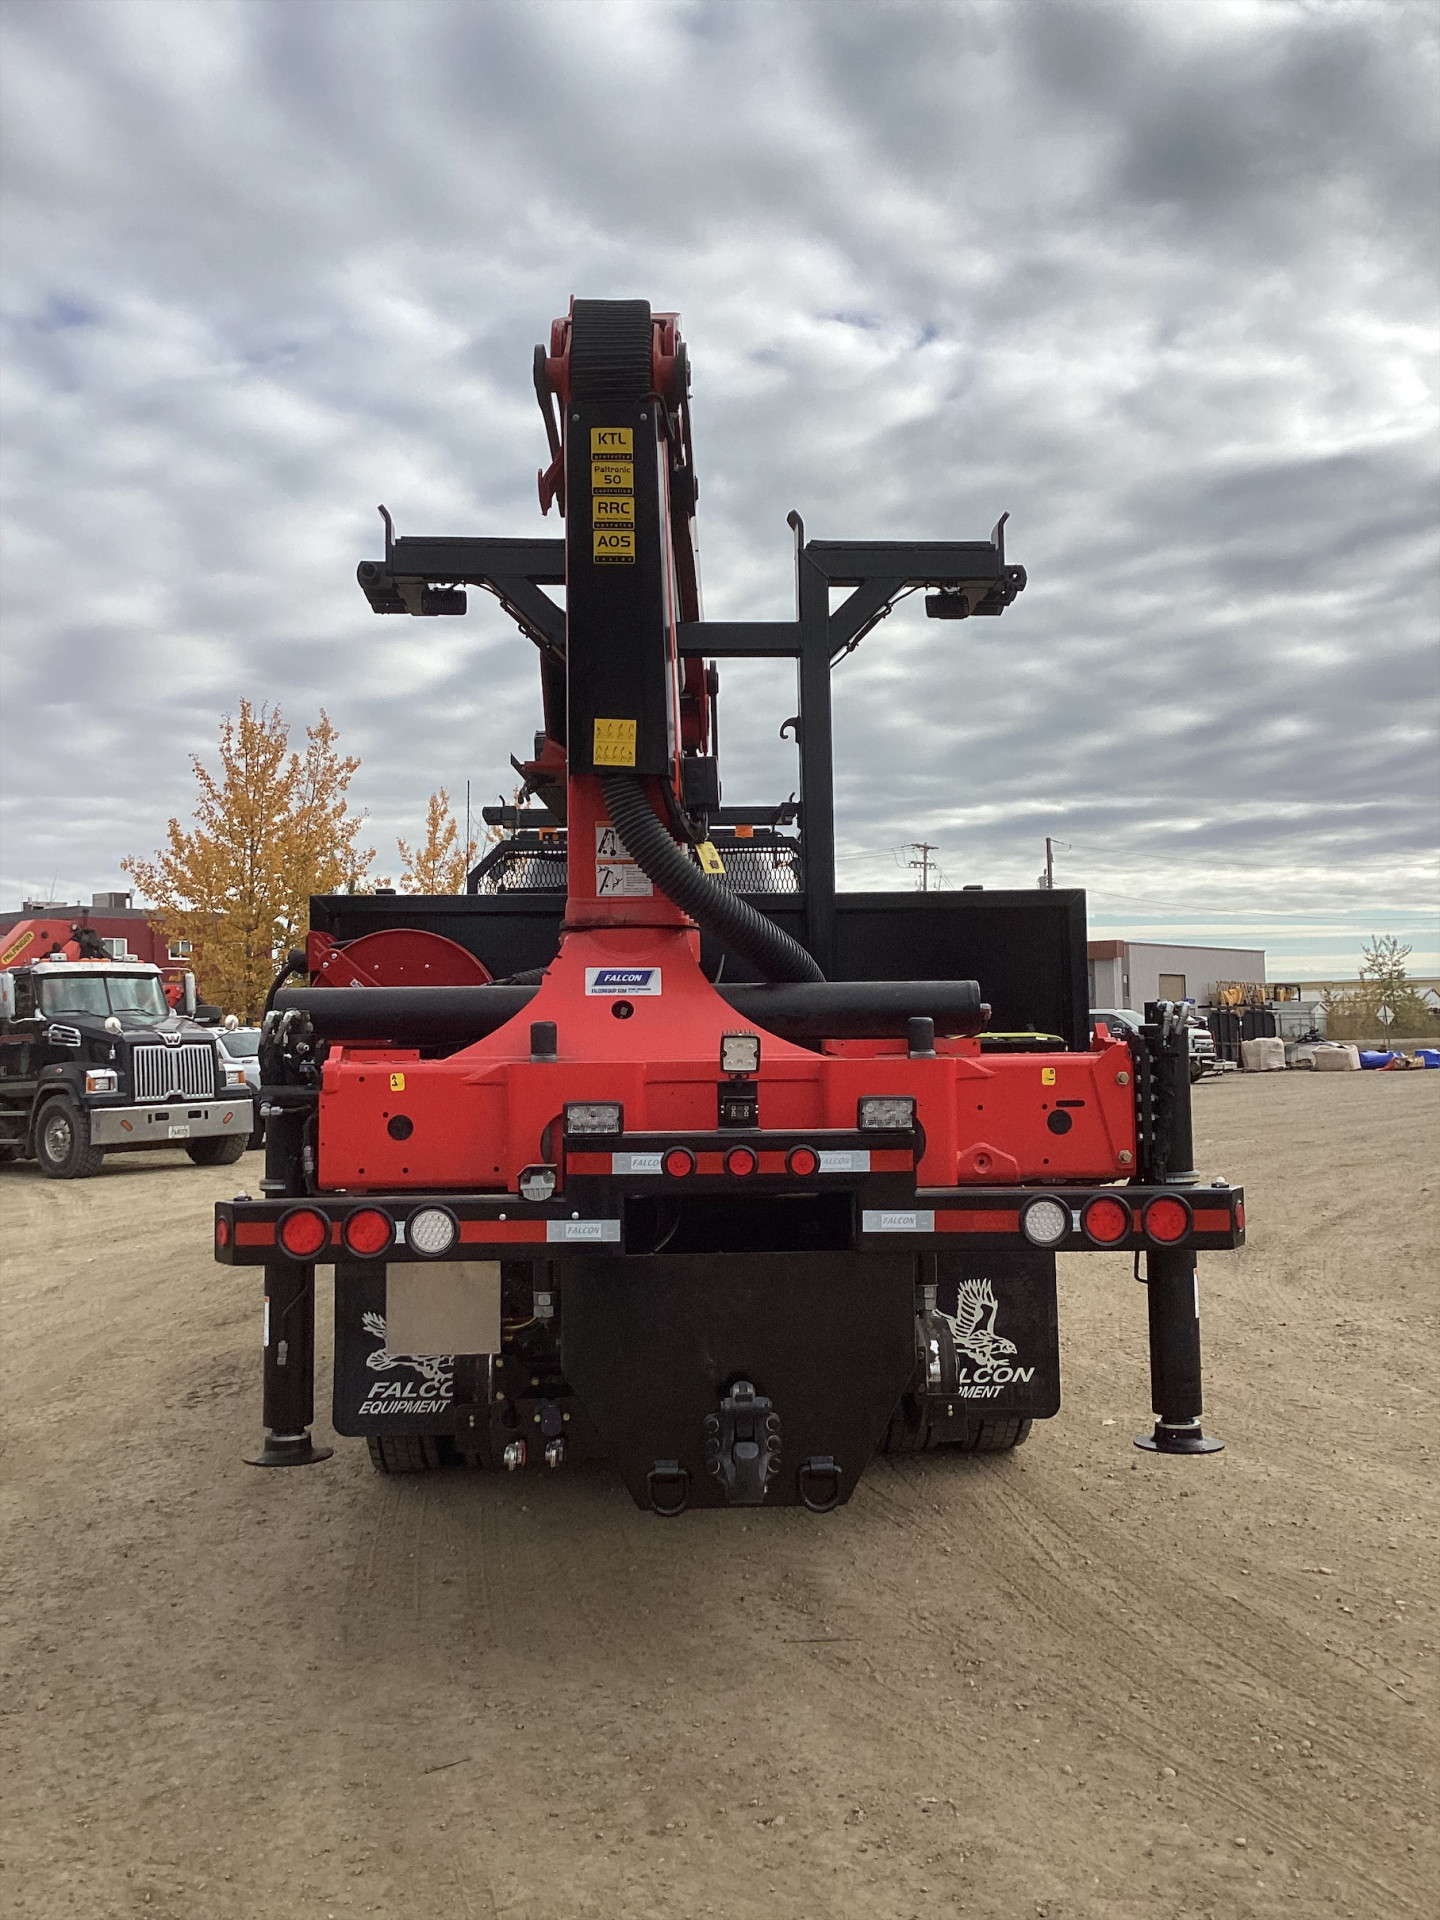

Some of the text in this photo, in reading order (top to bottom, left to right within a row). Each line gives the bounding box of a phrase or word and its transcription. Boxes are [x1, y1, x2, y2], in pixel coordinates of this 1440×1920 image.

[598, 432, 627, 445] KTL
[594, 465, 631, 473] Paltronic
[604, 474, 622, 485] 50
[598, 501, 631, 514] RRC
[597, 535, 631, 548] AOS
[604, 974, 643, 982] FALCON
[882, 1217, 915, 1225] FALCON
[567, 1226, 600, 1235] FALCON
[959, 1367, 1035, 1384] LCON
[367, 1381, 454, 1399] FALCO
[358, 1400, 451, 1415] EQUIPMENT
